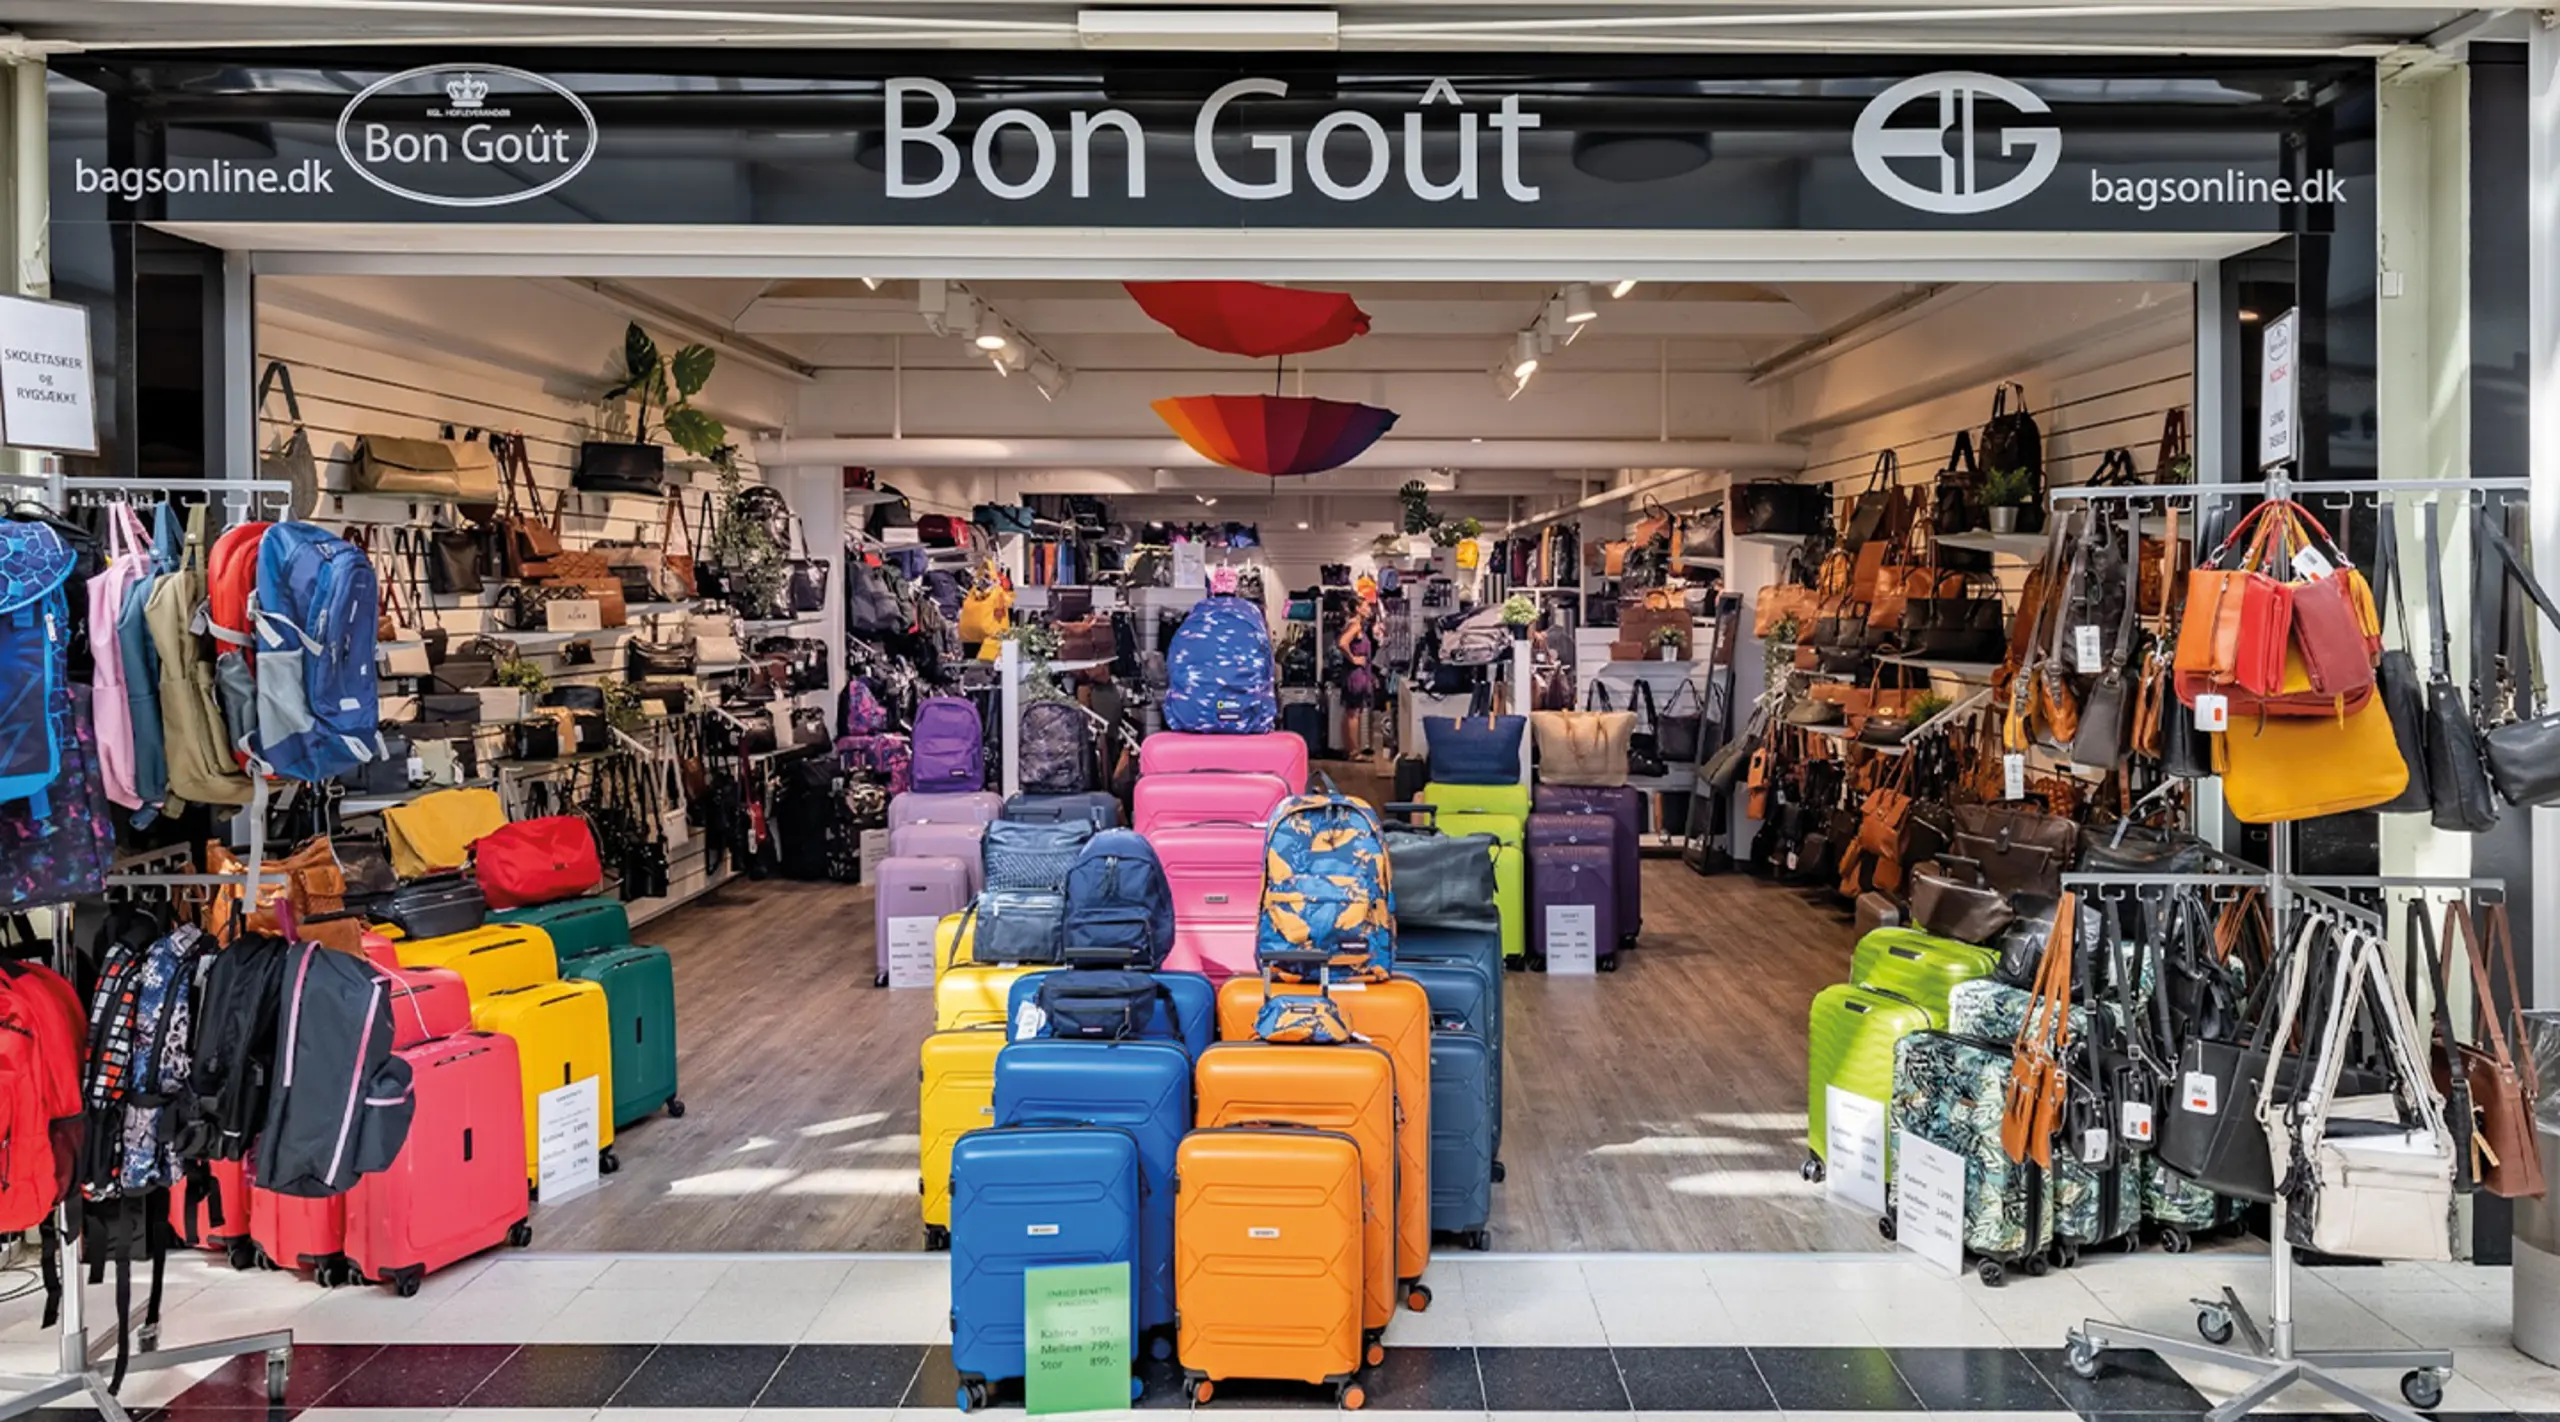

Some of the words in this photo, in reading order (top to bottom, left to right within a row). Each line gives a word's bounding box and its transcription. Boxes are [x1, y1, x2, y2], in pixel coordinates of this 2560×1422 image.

[366, 124, 448, 163] Bon
[462, 124, 570, 163] Goût
[884, 77, 1146, 199] Bon
[1194, 76, 1540, 202] Goût
[75, 158, 334, 201] bagsonline.dk
[2091, 168, 2347, 211] bagsonline.dk
[4, 349, 82, 370] SKOLETASKER
[38, 373, 53, 386] og
[16, 387, 77, 405] RYGSÆKKE
[1041, 1329, 1079, 1340] Kabine
[1041, 1343, 1083, 1354] Mellem
[1040, 1360, 1063, 1371] Stor
